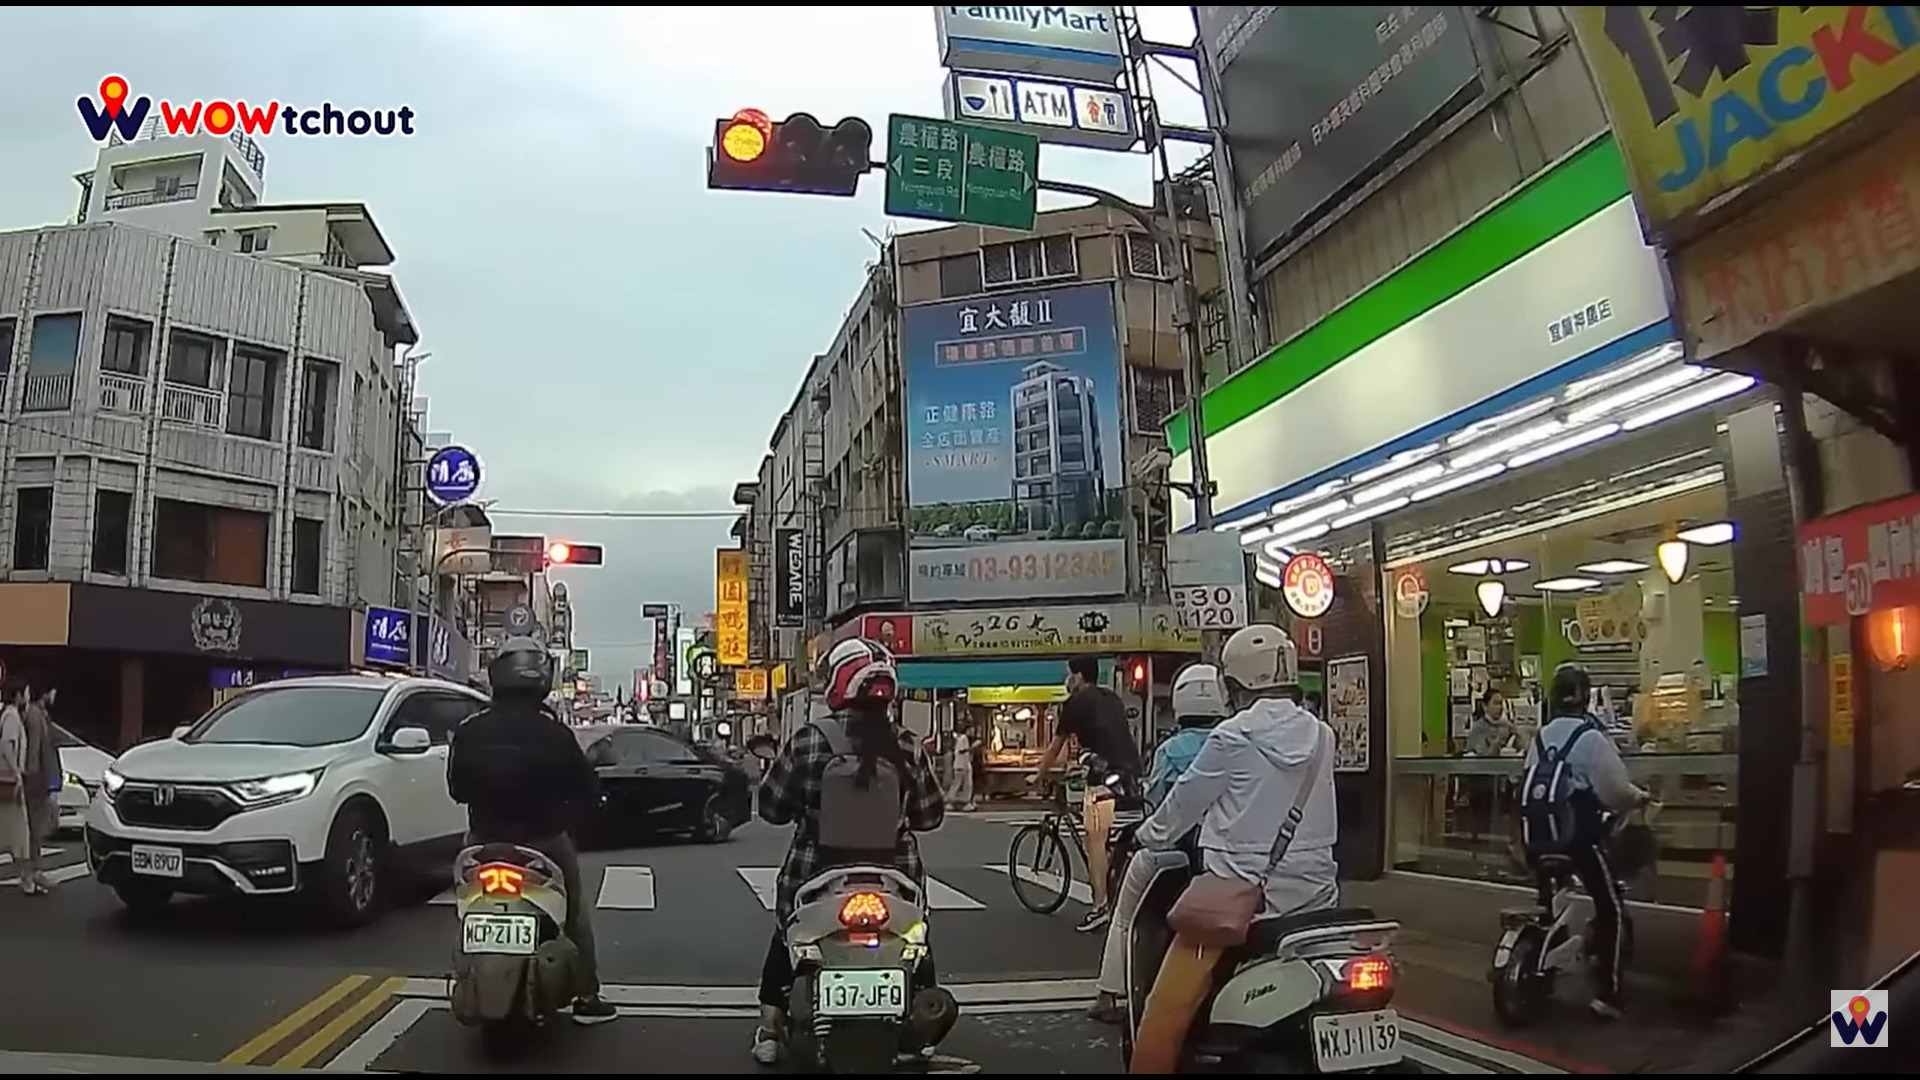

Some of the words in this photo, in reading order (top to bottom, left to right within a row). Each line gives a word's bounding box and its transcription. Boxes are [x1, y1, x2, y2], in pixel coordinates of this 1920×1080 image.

[1024, 90, 1068, 118] ATM
[912, 155, 954, 181] 二段
[968, 550, 1118, 583] 03-9312345
[1190, 607, 1235, 627] 120
[824, 985, 902, 1007] 137-JFQ
